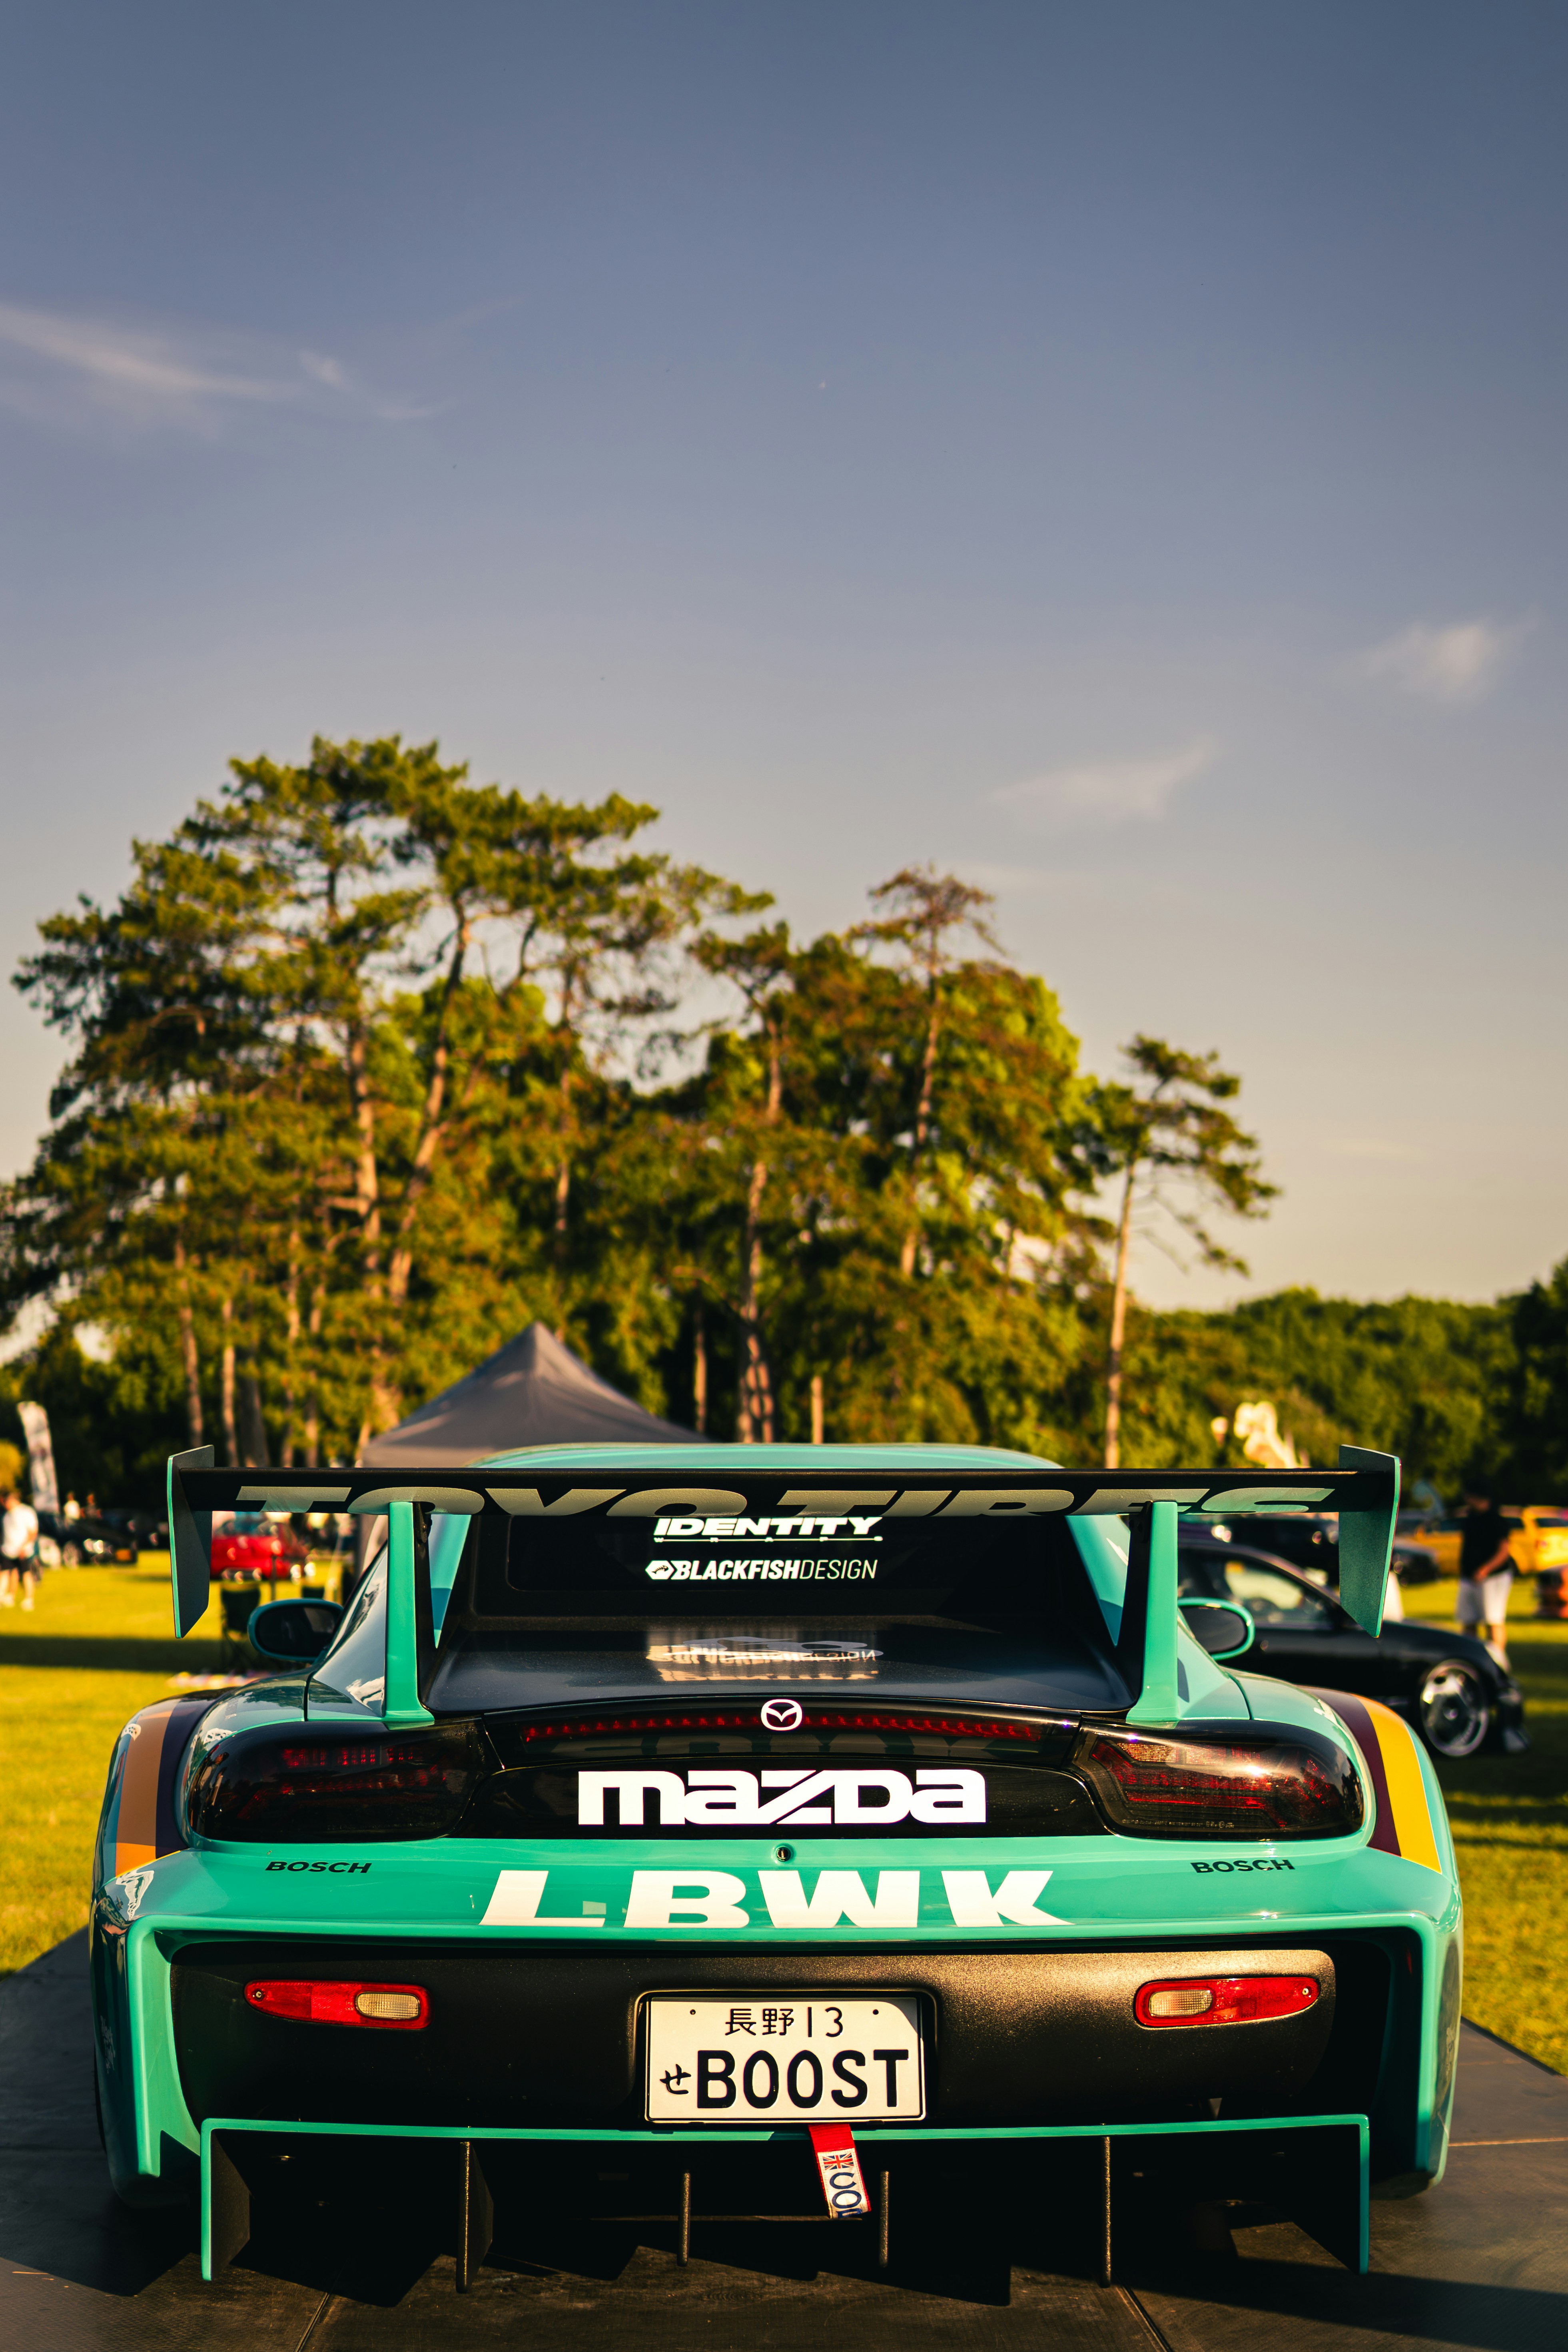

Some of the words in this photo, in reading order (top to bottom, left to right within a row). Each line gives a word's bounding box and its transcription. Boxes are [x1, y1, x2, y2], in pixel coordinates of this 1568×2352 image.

[236, 1487, 747, 1516] TOYO
[654, 1517, 883, 1535] IDENTITY
[265, 1861, 372, 1873] BOSCH
[1190, 1859, 1295, 1873] BOSCH
[479, 1870, 1075, 1927] LBWK
[660, 2064, 691, 2095] せ
[697, 2050, 909, 2109] BOOST
